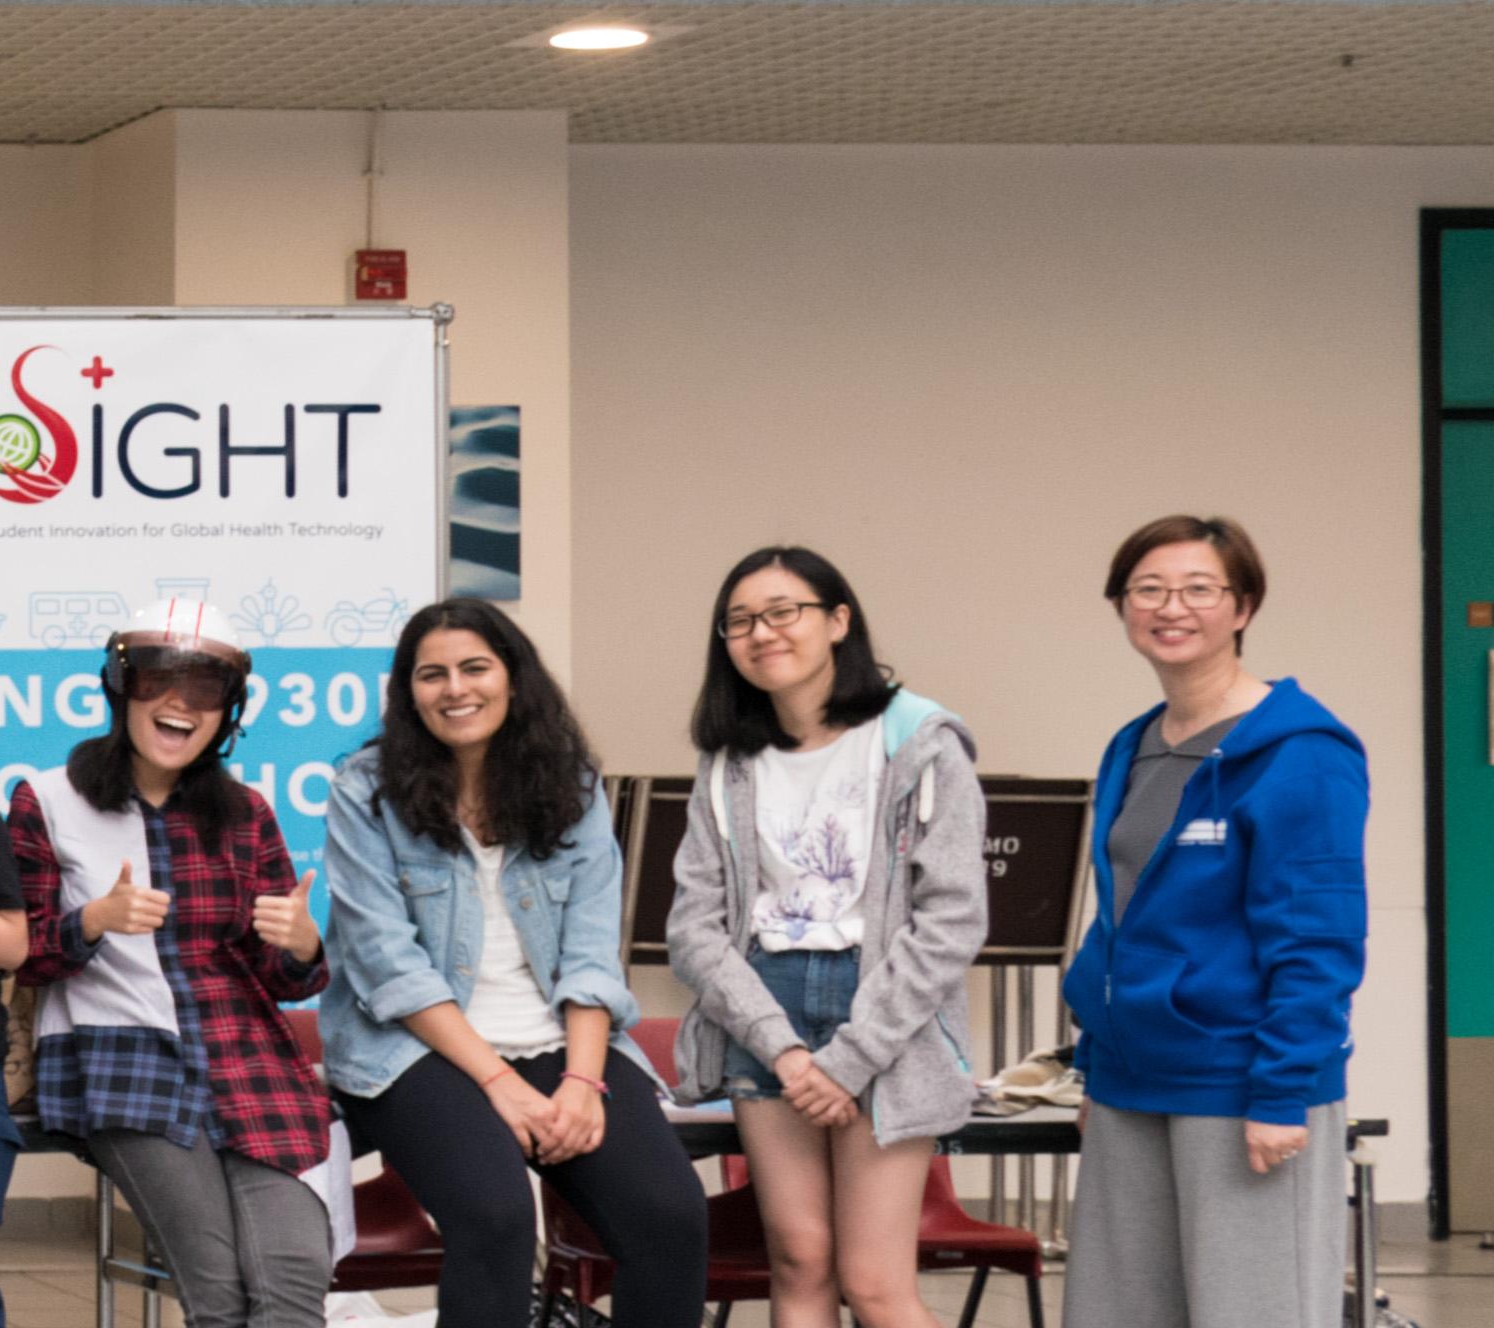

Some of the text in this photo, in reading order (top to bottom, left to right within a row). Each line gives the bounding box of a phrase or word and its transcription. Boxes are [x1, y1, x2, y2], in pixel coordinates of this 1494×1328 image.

[49, 523, 137, 539] Innovation
[142, 523, 165, 539] for
[170, 523, 225, 539] Global
[230, 523, 283, 539] Health
[288, 523, 384, 539] Technology
